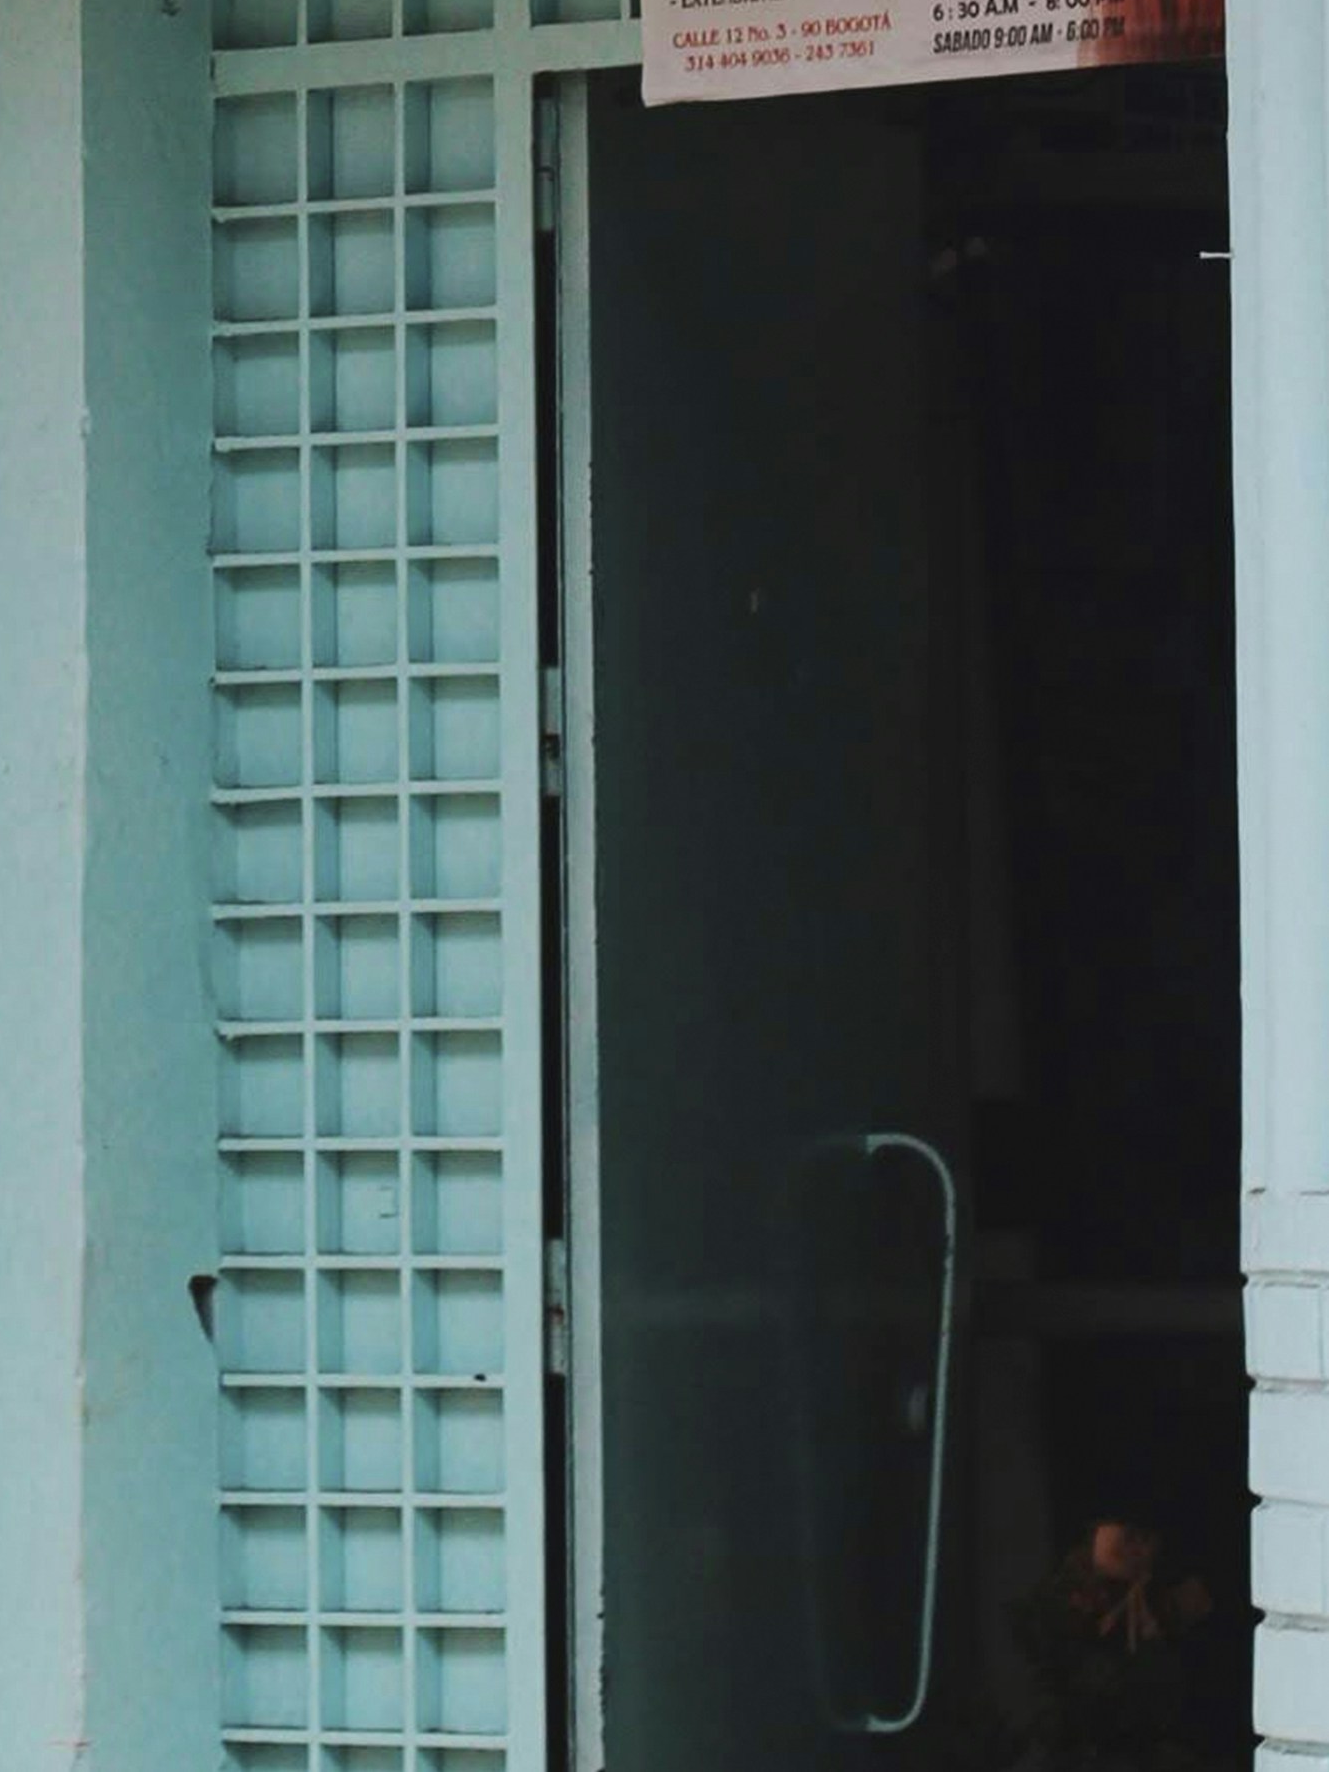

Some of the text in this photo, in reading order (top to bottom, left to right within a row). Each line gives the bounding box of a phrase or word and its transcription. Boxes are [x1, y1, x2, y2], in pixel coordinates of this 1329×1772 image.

[673, 30, 720, 49] CALLE
[726, 27, 742, 44] 12
[826, 10, 892, 36] BOGOTÁ
[933, 29, 991, 54] SABADO
[994, 24, 1027, 49] 9:00
[1030, 22, 1053, 44] AM
[1103, 16, 1125, 37] PM
